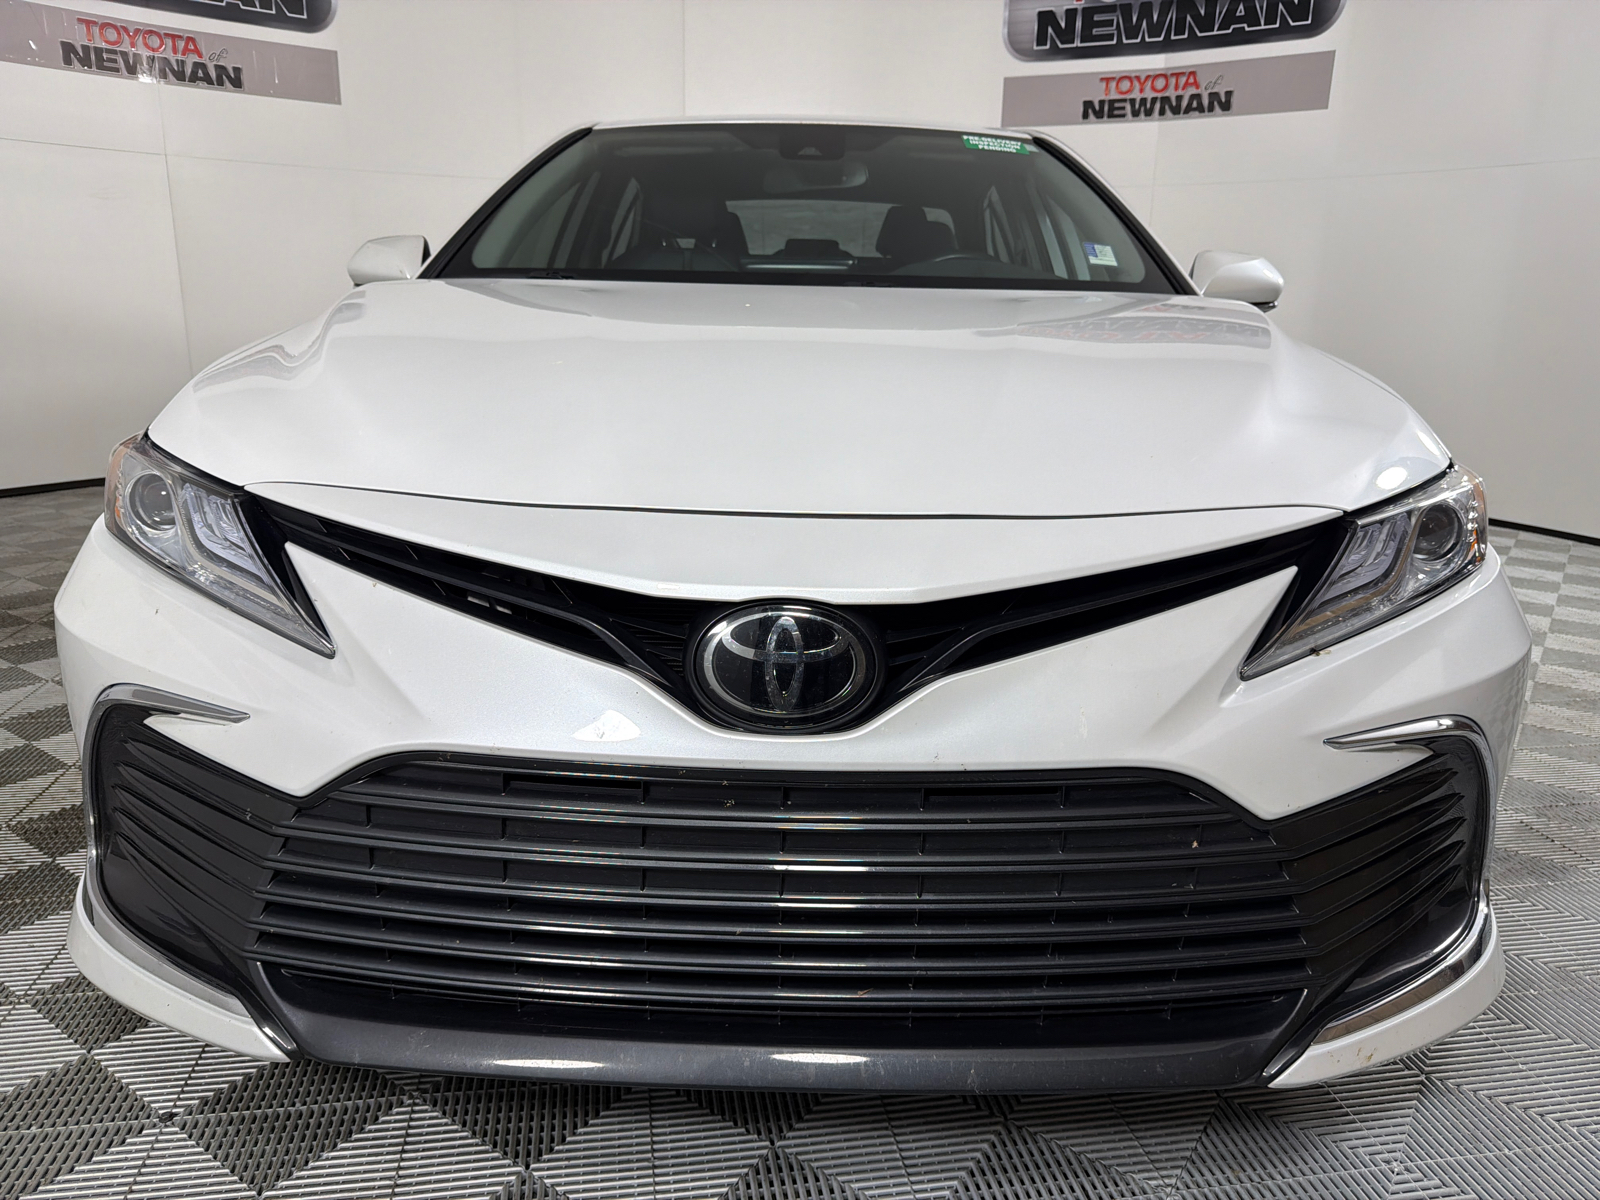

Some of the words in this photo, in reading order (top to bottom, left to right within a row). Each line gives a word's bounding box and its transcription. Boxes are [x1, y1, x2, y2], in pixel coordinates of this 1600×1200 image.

[76, 17, 203, 59] TOYOTA
[208, 48, 228, 62] of
[1033, 0, 1314, 50] NEWNAN
[60, 40, 243, 89] NEWNAN
[1100, 70, 1200, 96] TOYOTA
[1204, 75, 1223, 91] of
[1082, 91, 1234, 119] NEWNAN
[978, 145, 1016, 153] PENDING
